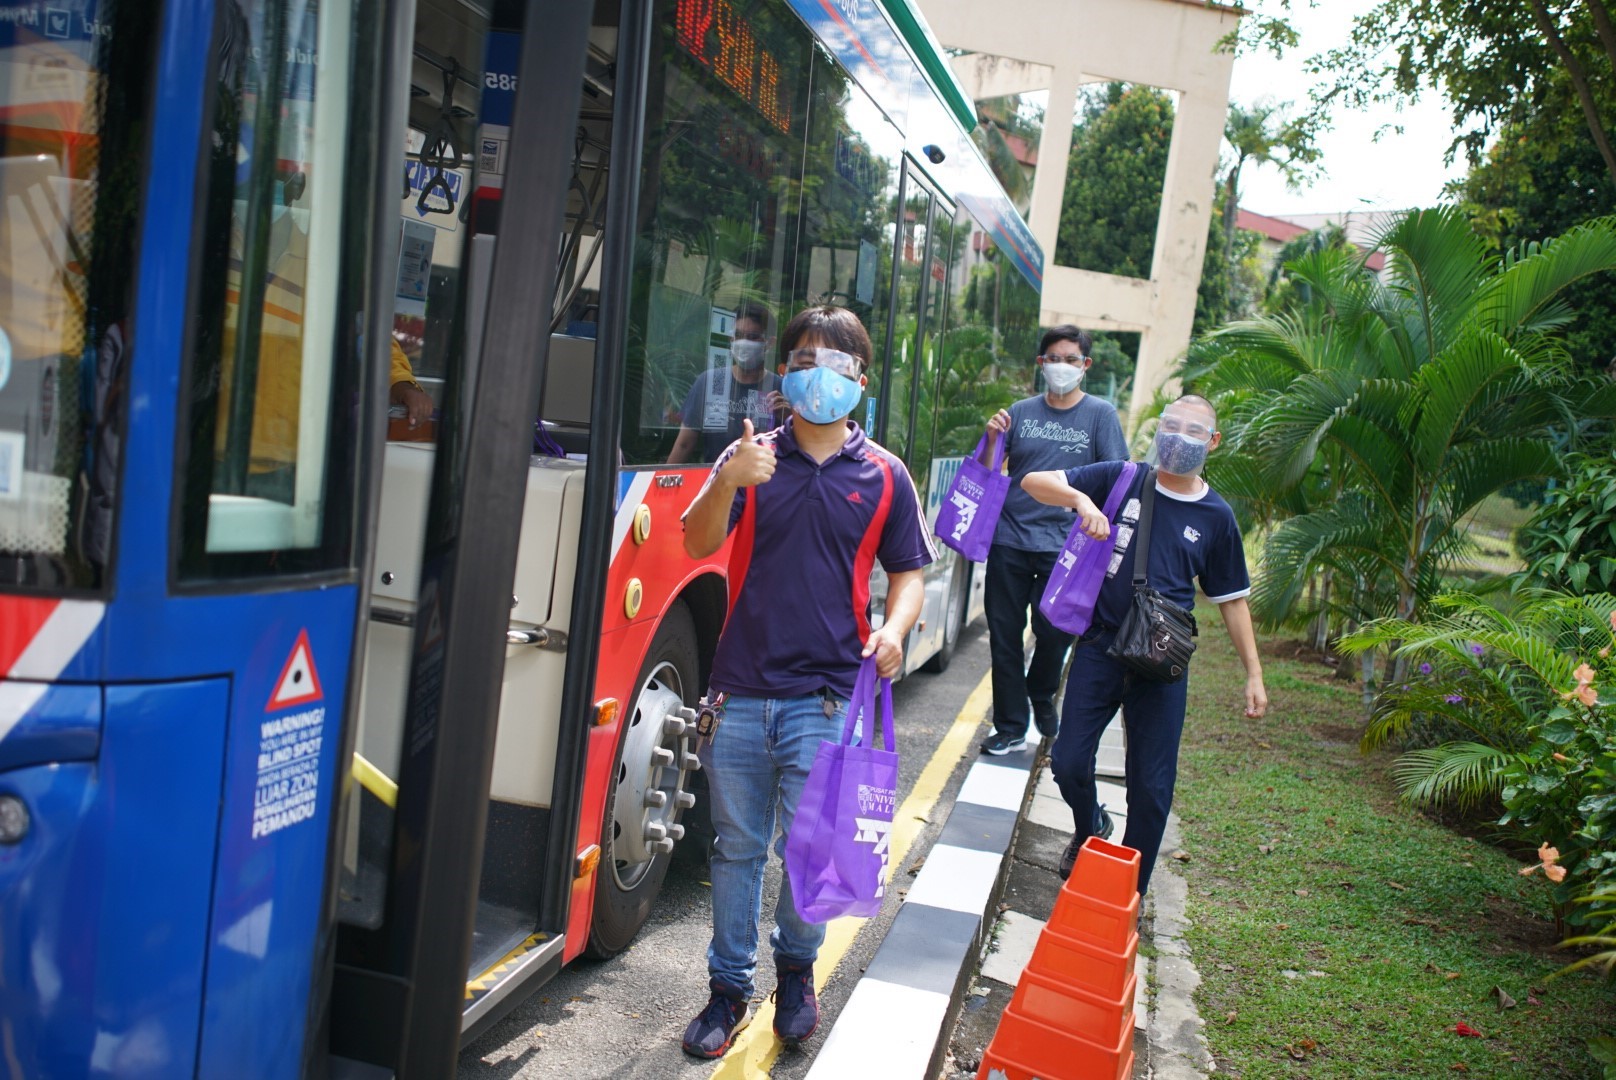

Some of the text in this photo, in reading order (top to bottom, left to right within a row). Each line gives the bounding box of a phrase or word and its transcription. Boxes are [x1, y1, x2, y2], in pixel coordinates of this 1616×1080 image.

[1020, 419, 1090, 444] Hollister
[260, 707, 326, 740] WARNING!
[257, 737, 323, 770] BLIND SPOT
[254, 769, 319, 807] LUAR ZON
[251, 800, 316, 841] PEMANDU
[868, 802, 895, 814] MAL
